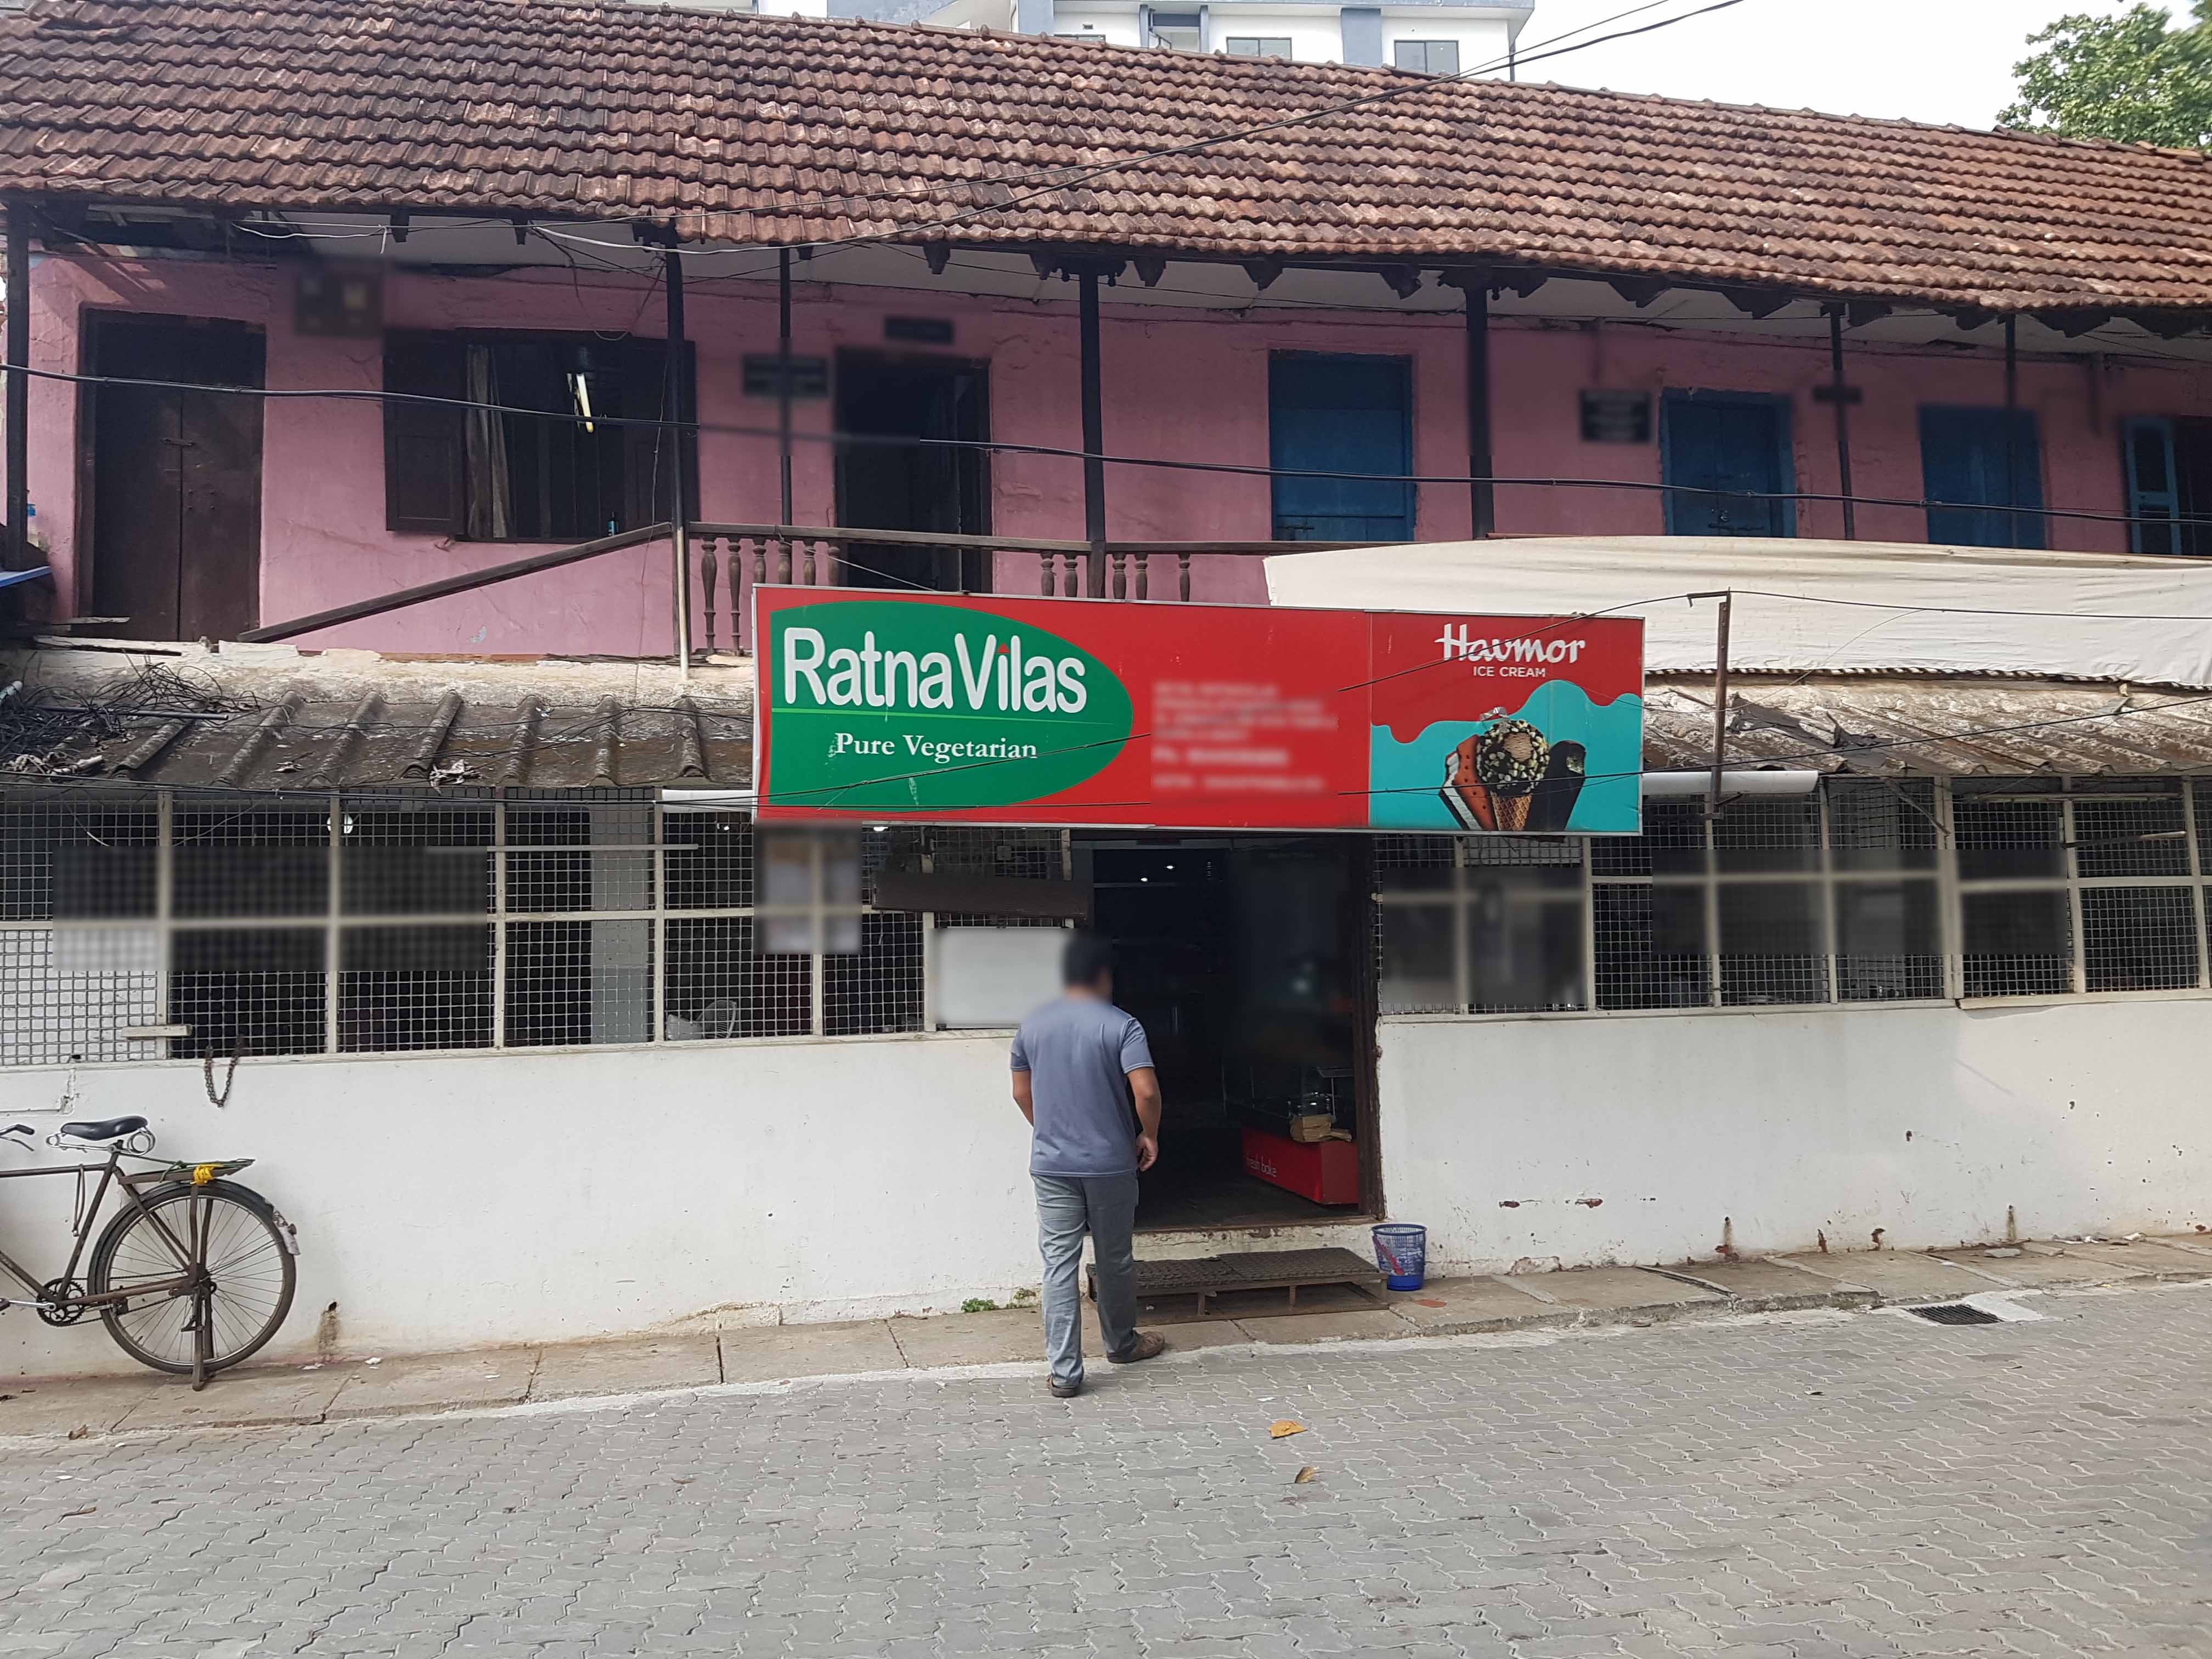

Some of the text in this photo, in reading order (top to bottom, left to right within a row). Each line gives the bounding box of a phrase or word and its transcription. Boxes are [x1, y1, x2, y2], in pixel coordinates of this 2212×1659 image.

[1434, 623, 1586, 663] Havmor
[1473, 666, 1546, 677] ICE CREAM
[834, 732, 1038, 764] Pure Vegetarian
